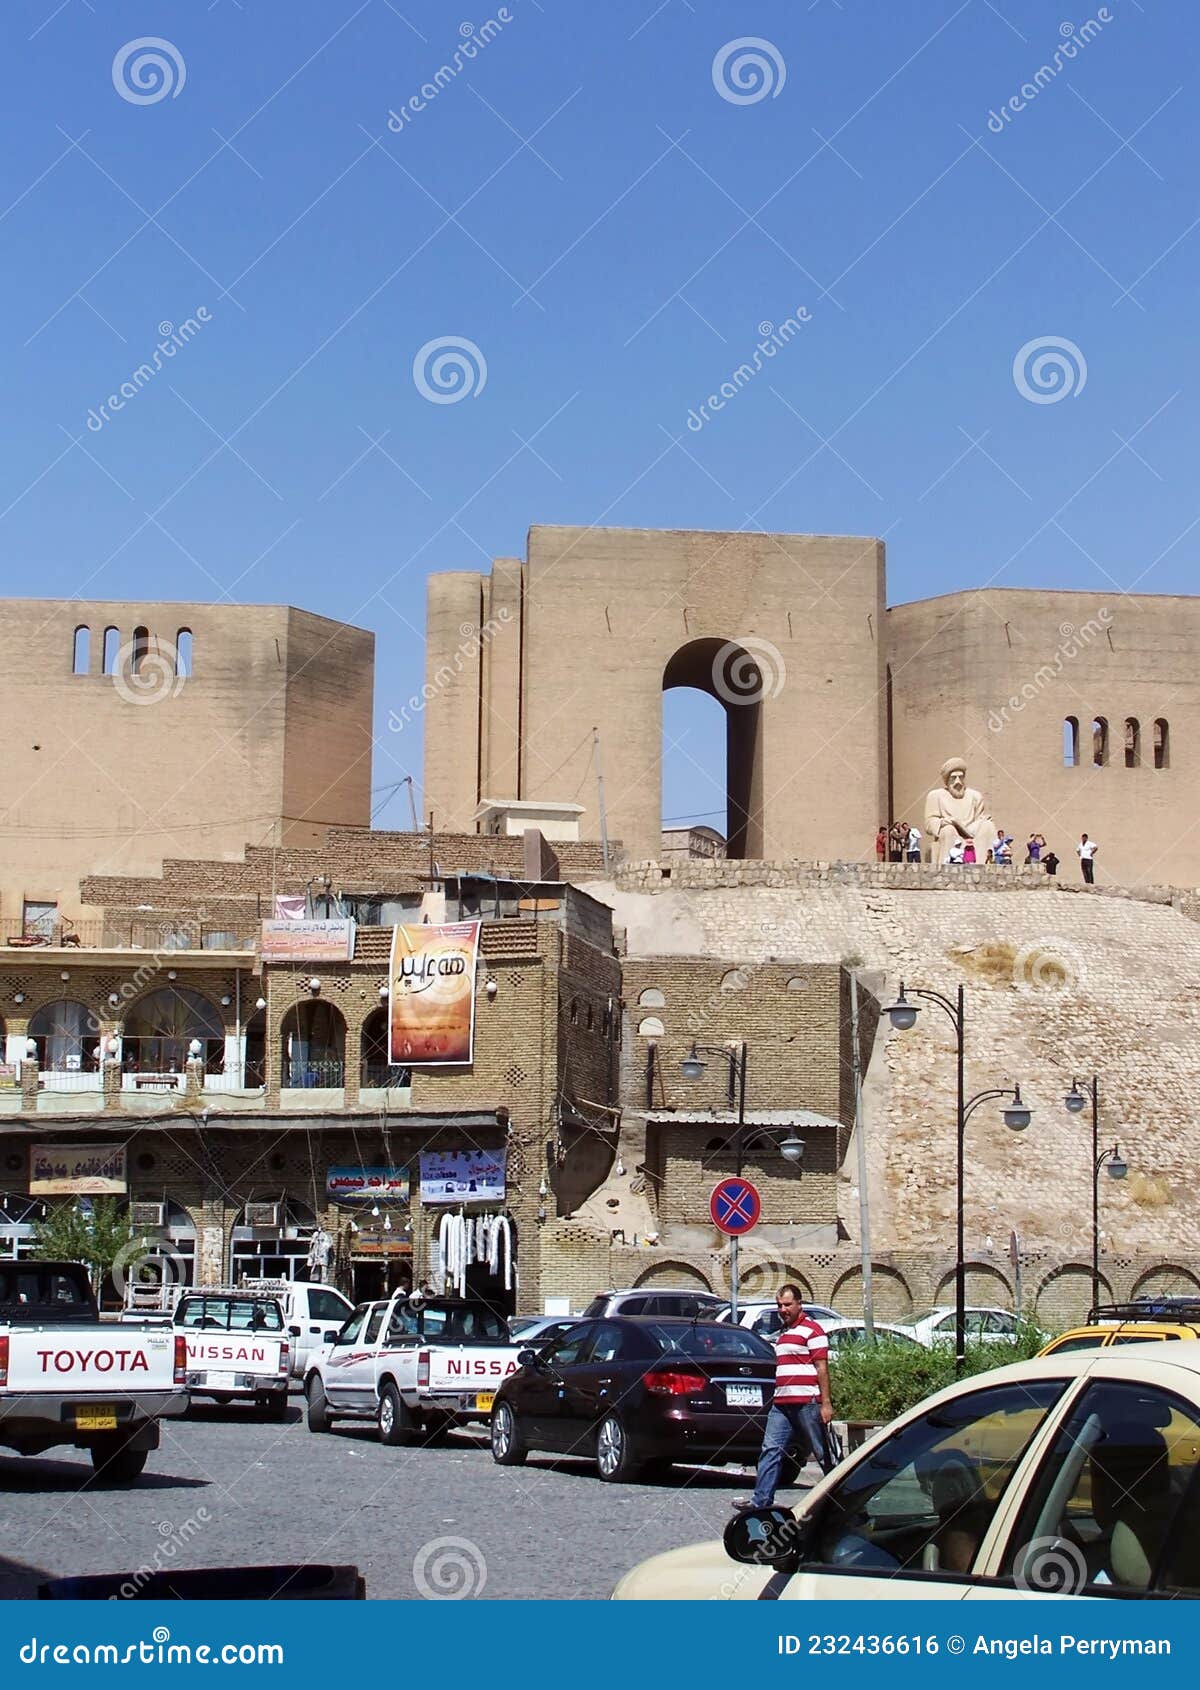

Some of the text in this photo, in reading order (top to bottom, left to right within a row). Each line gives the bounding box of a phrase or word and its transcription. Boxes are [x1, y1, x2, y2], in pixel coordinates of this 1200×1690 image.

[37, 1350, 149, 1372] TOYOTA
[186, 1345, 264, 1361] NISSAN
[447, 1359, 517, 1376] NISSA
